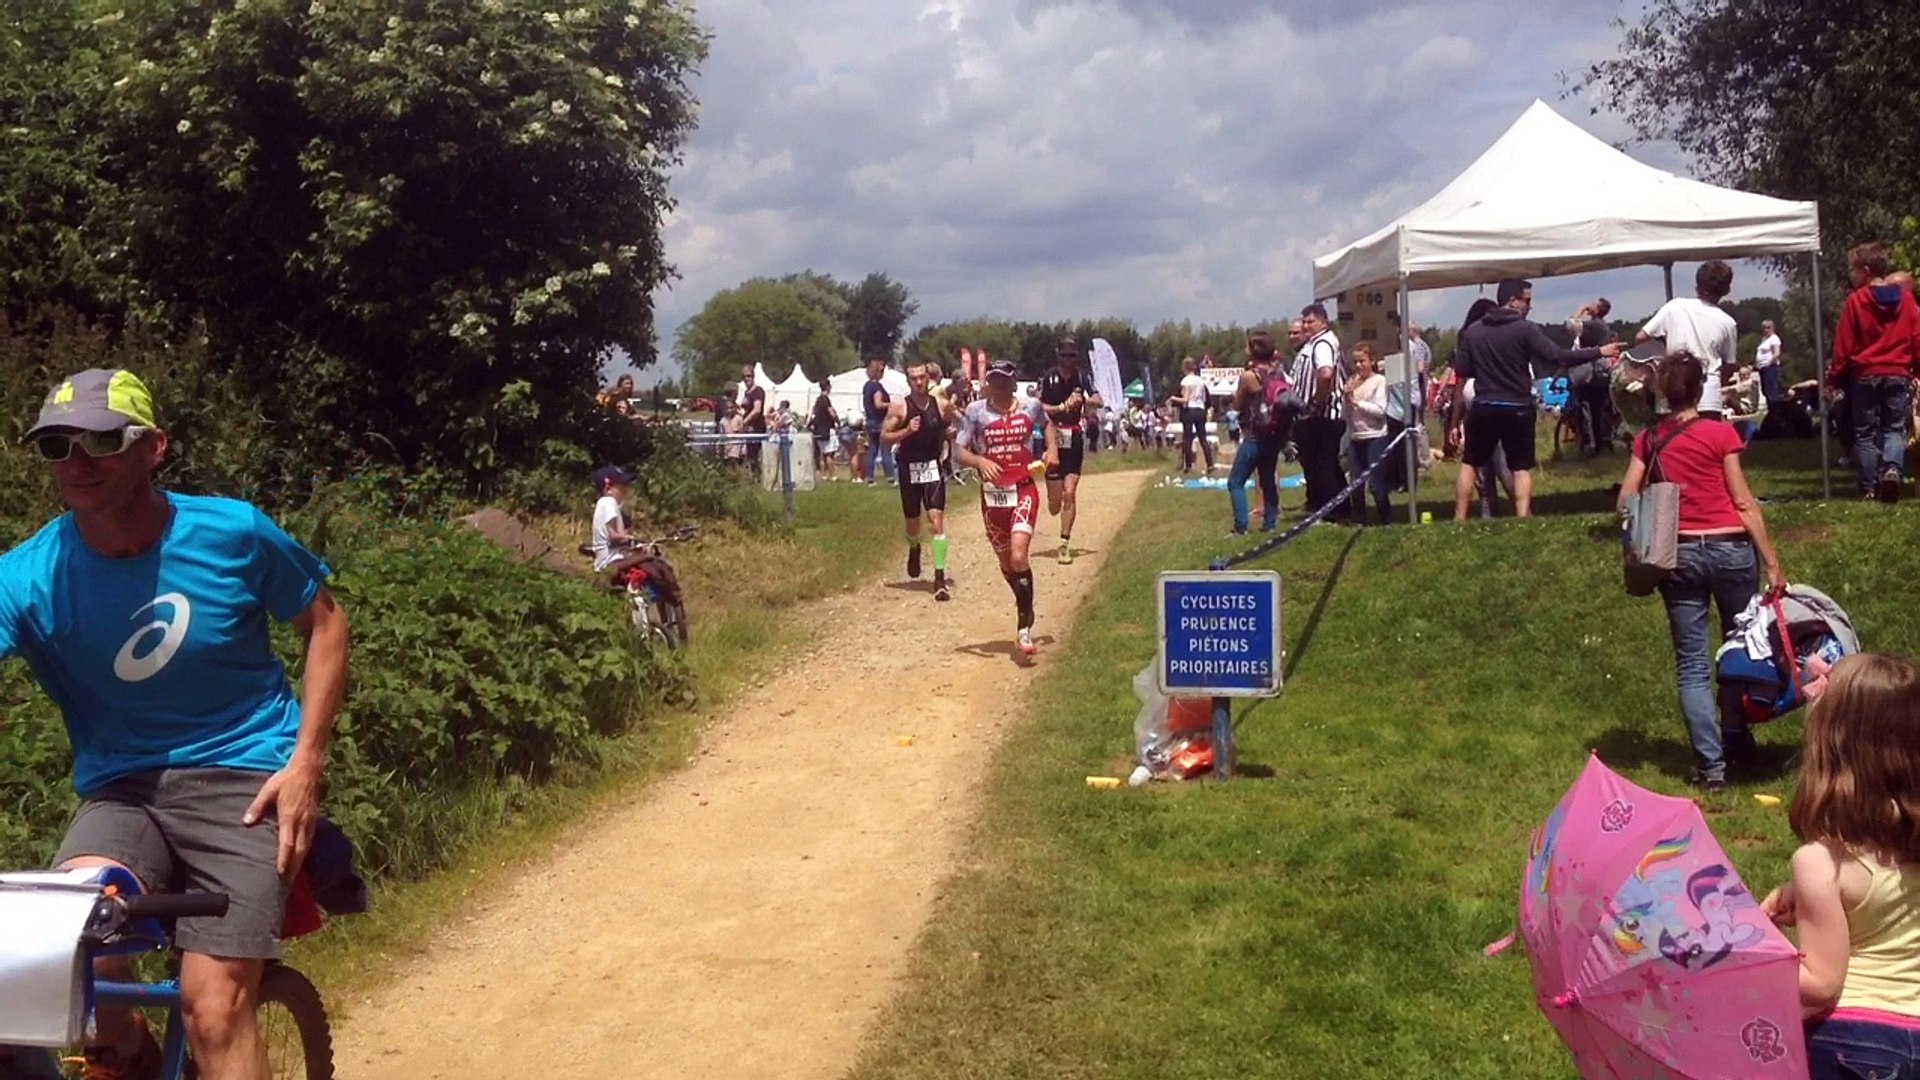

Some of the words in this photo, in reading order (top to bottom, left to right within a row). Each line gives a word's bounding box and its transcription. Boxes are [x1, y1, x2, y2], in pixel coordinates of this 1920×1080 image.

[1180, 595, 1256, 609] CYCLISTES
[1180, 617, 1257, 631] PRUDENCE
[1189, 635, 1249, 652] PIÉTONS
[1170, 660, 1269, 675] PRIORITAIRES
